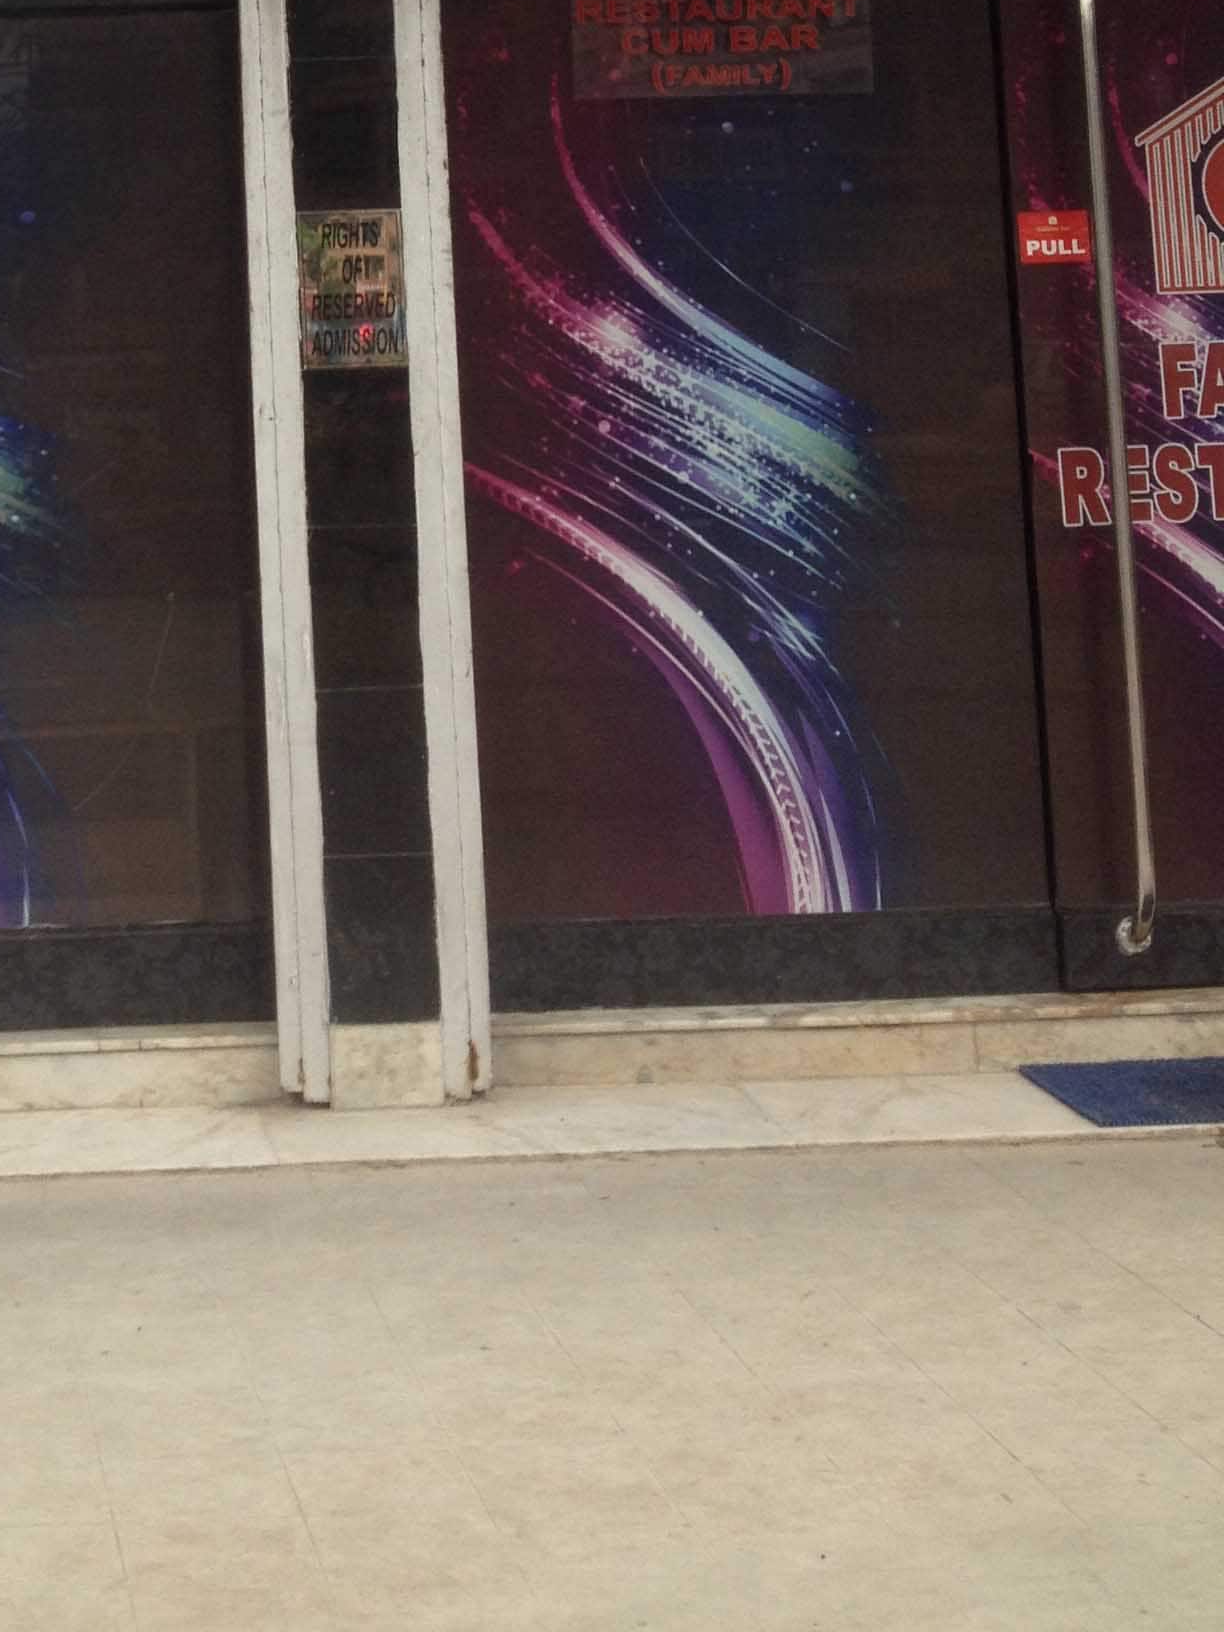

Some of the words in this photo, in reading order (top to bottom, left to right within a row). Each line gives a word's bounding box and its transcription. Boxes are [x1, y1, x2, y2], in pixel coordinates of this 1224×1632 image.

[621, 24, 714, 55] CUM
[729, 23, 820, 53] BAR
[651, 57, 793, 94] (FAMILY)
[321, 222, 379, 249] RIGHTS
[1026, 238, 1086, 256] PULL
[312, 291, 397, 320] RESERVED
[311, 326, 399, 356] ADMISSION
